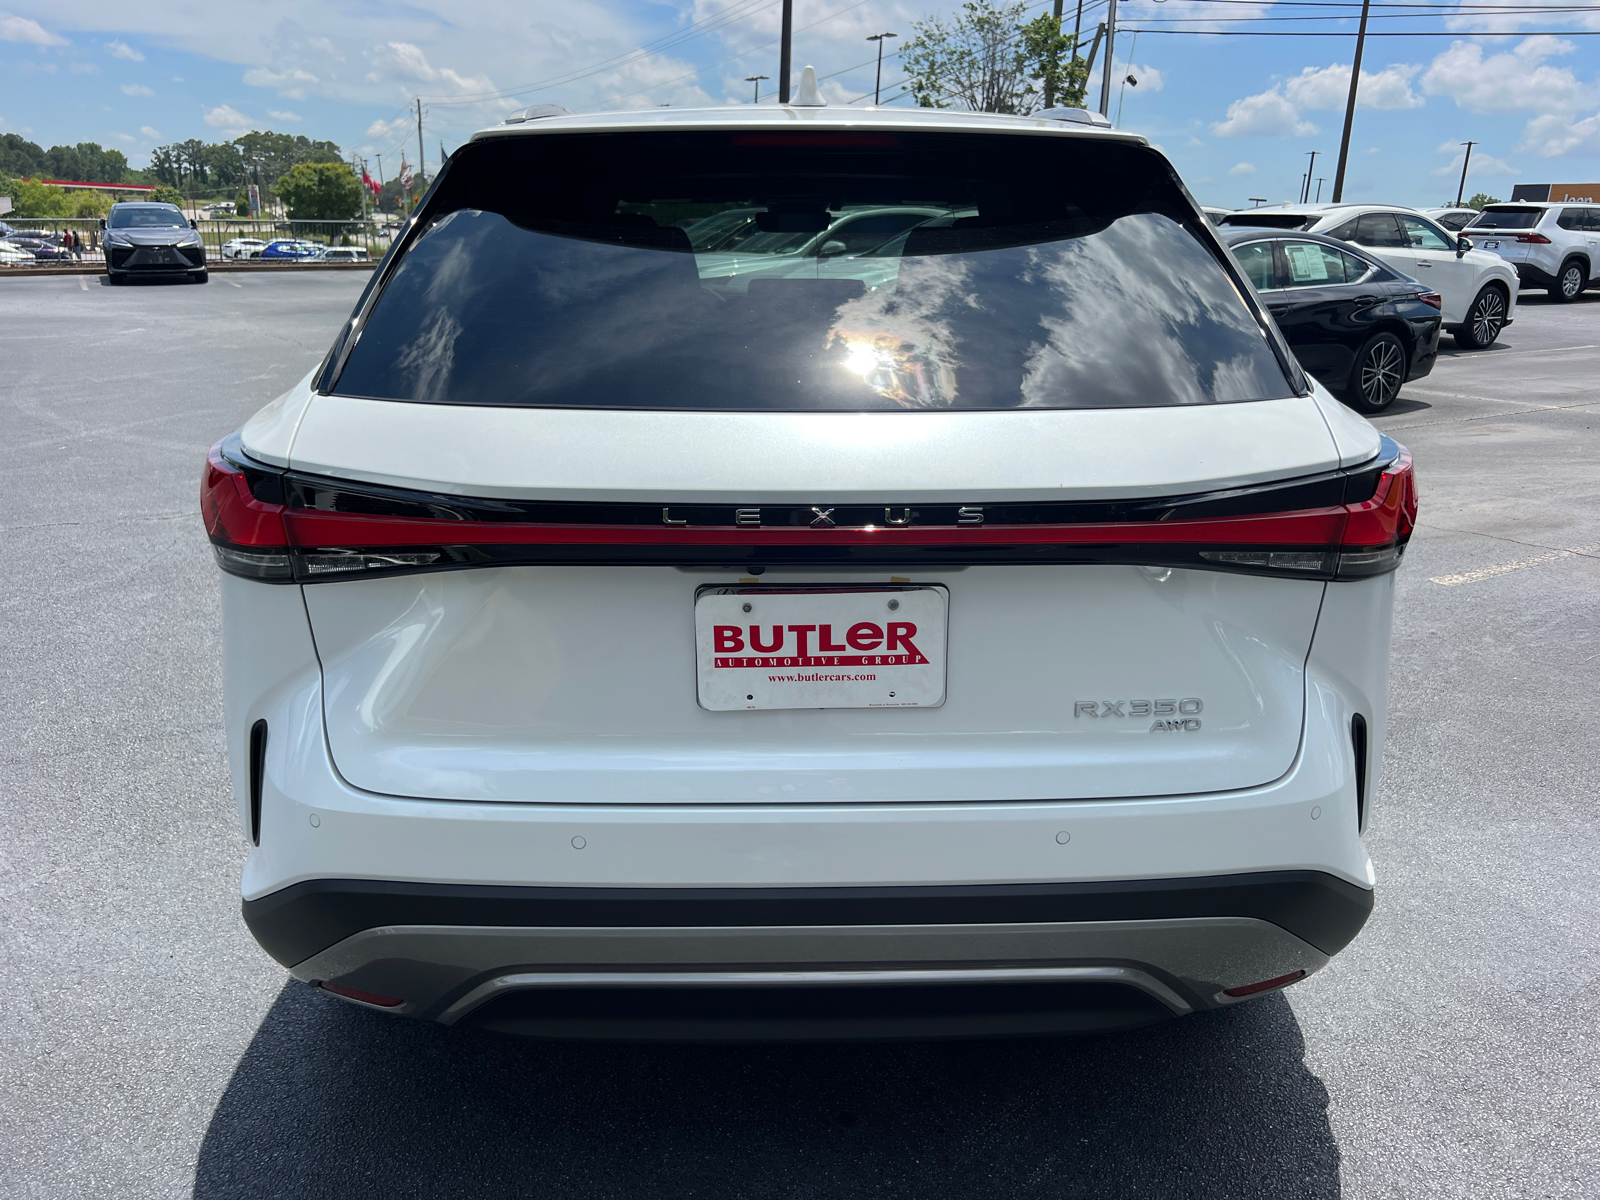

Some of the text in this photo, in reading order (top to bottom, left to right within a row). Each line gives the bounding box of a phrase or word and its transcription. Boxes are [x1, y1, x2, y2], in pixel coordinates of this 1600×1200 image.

[662, 507, 985, 525] LEXUS
[716, 654, 922, 667] AUTOMOTIVE GROUP
[768, 673, 876, 682] www.butlercars.com
[1149, 718, 1202, 732] AWD
